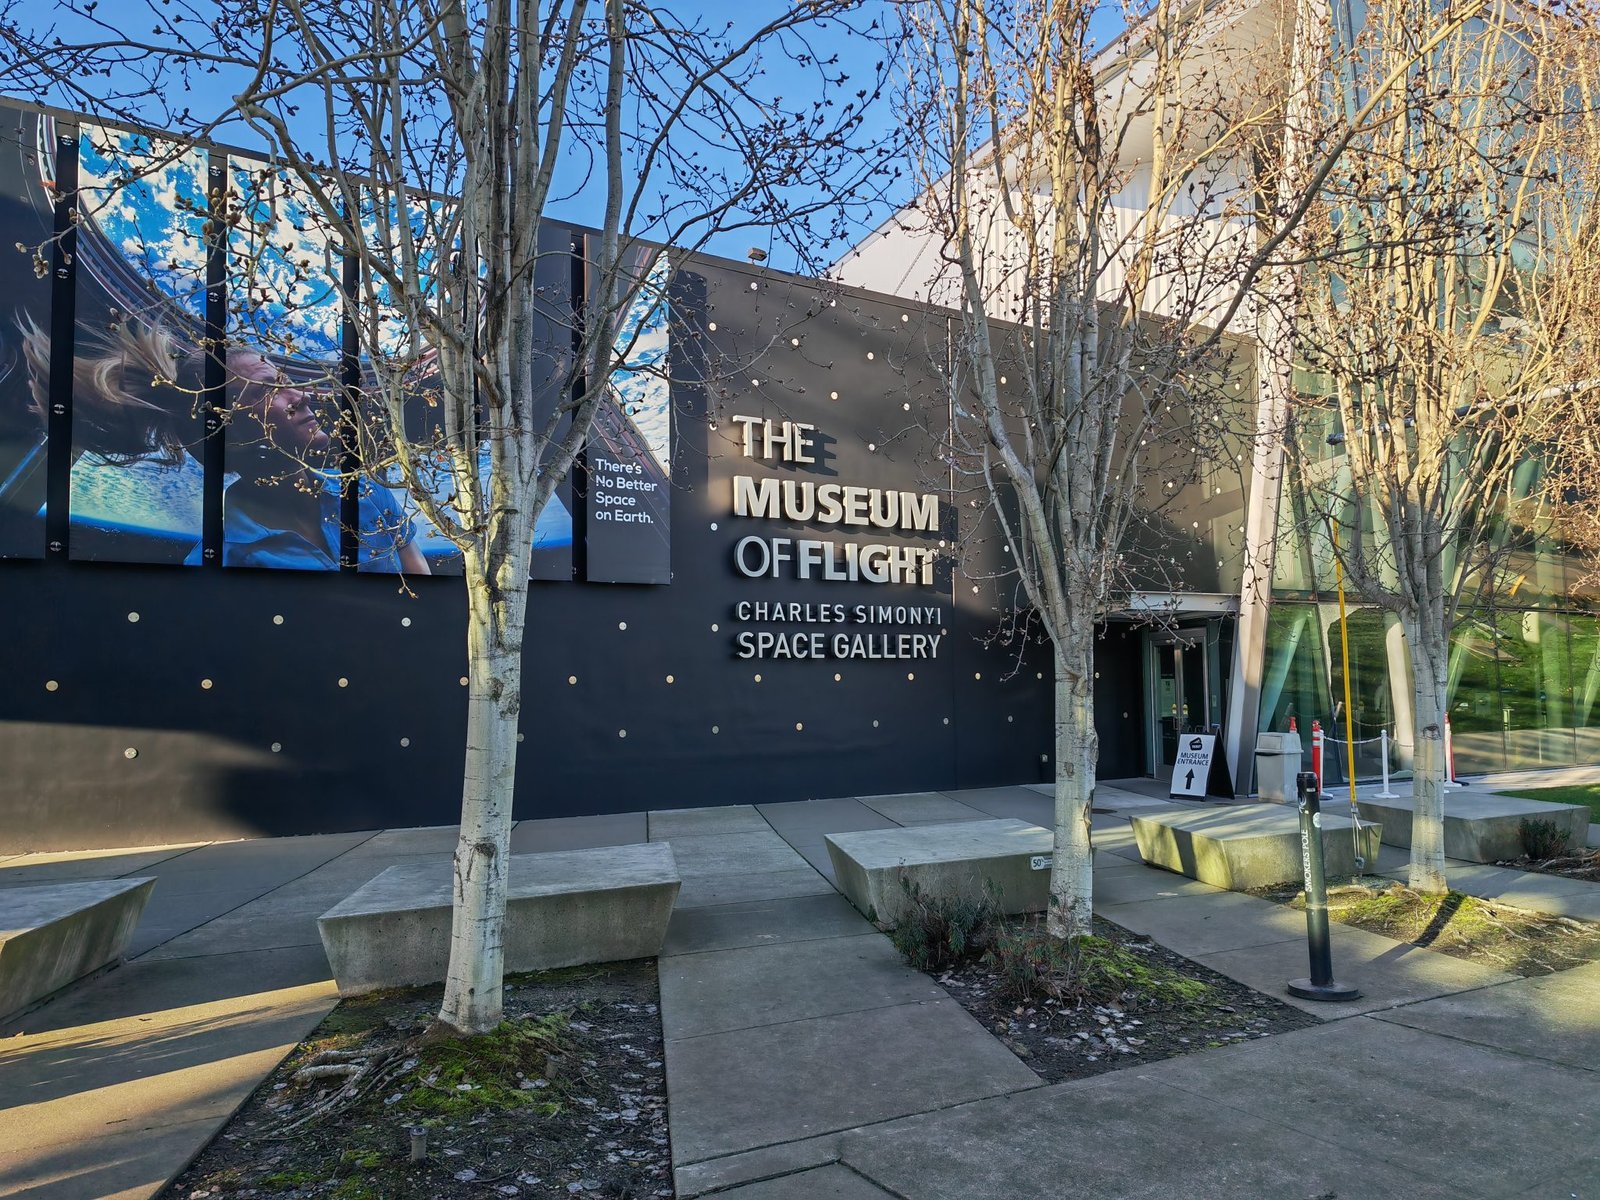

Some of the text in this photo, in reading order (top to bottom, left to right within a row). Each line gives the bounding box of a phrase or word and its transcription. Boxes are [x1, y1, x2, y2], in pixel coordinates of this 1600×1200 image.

[733, 415, 815, 463] THE
[595, 458, 642, 474] There's
[595, 475, 658, 492] No Better
[595, 491, 636, 507] Space
[733, 475, 939, 532] MUSEUM
[595, 509, 654, 524] on Earth.
[734, 535, 939, 585] OF FLIGHT
[736, 601, 942, 625] CHARLES SIMONYI
[736, 631, 941, 659] SPACE GALLERY
[1177, 758, 1210, 766] ENTRANCE
[1303, 852, 1312, 892] SMOKERS
